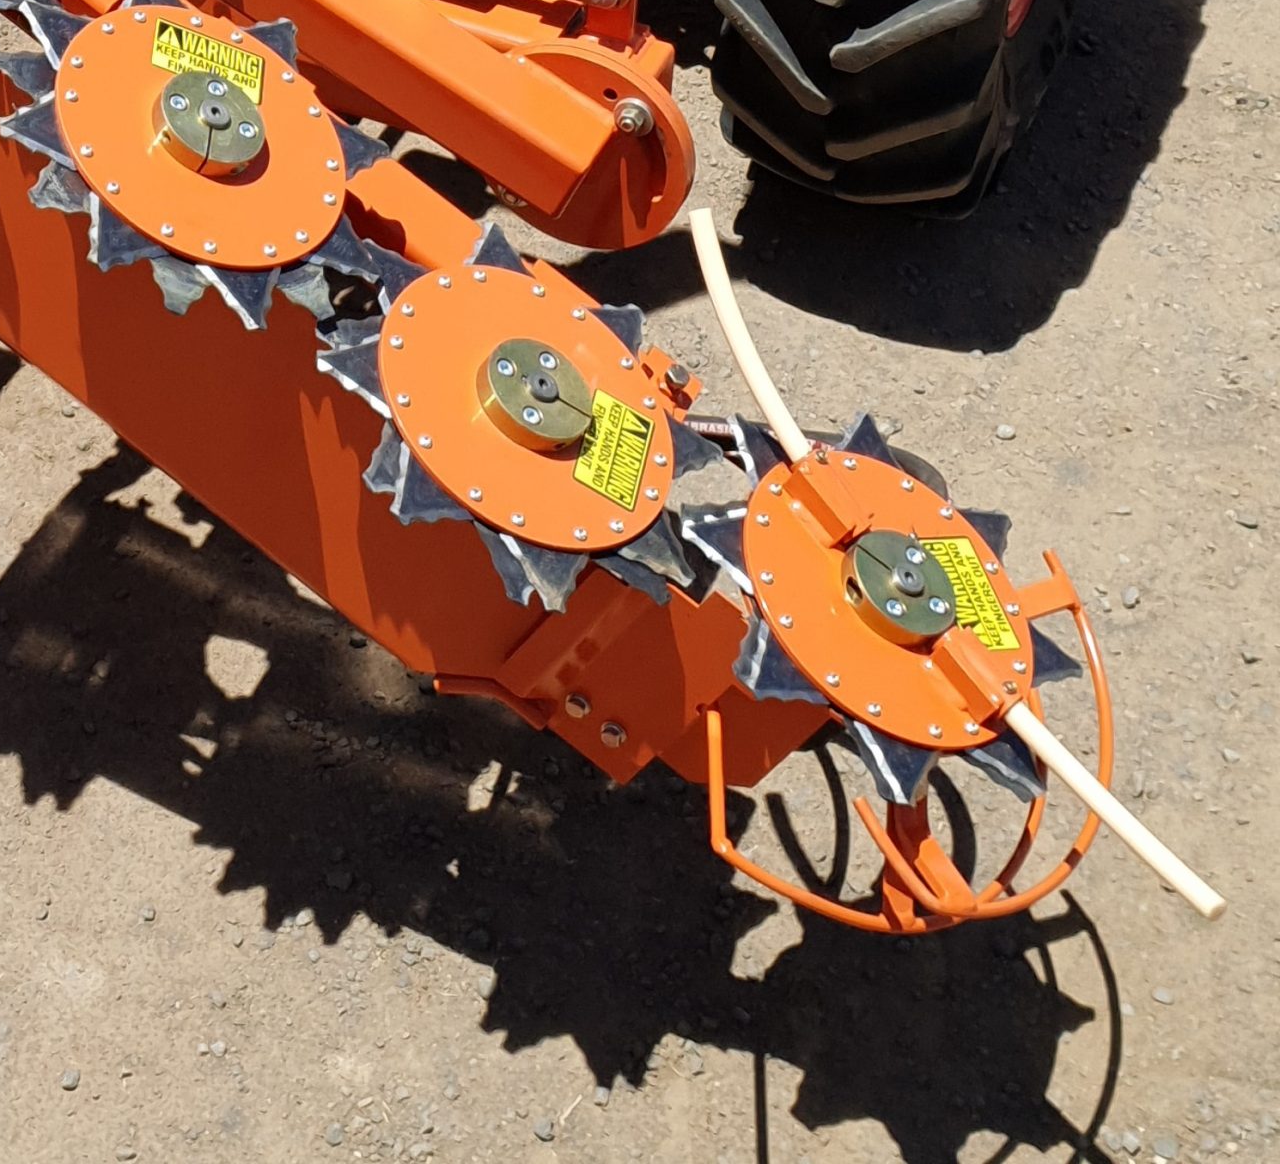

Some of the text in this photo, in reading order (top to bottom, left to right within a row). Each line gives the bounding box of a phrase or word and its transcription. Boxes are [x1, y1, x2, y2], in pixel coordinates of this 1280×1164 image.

[156, 44, 256, 89] KEEP HANDS AND
[182, 29, 259, 79] WARNING
[592, 401, 623, 488] KEEP HANDS AND
[606, 430, 646, 505] WARNING
[948, 542, 1004, 647] KEEP HANDS AND
[965, 555, 1010, 633] FINGERS OUT
